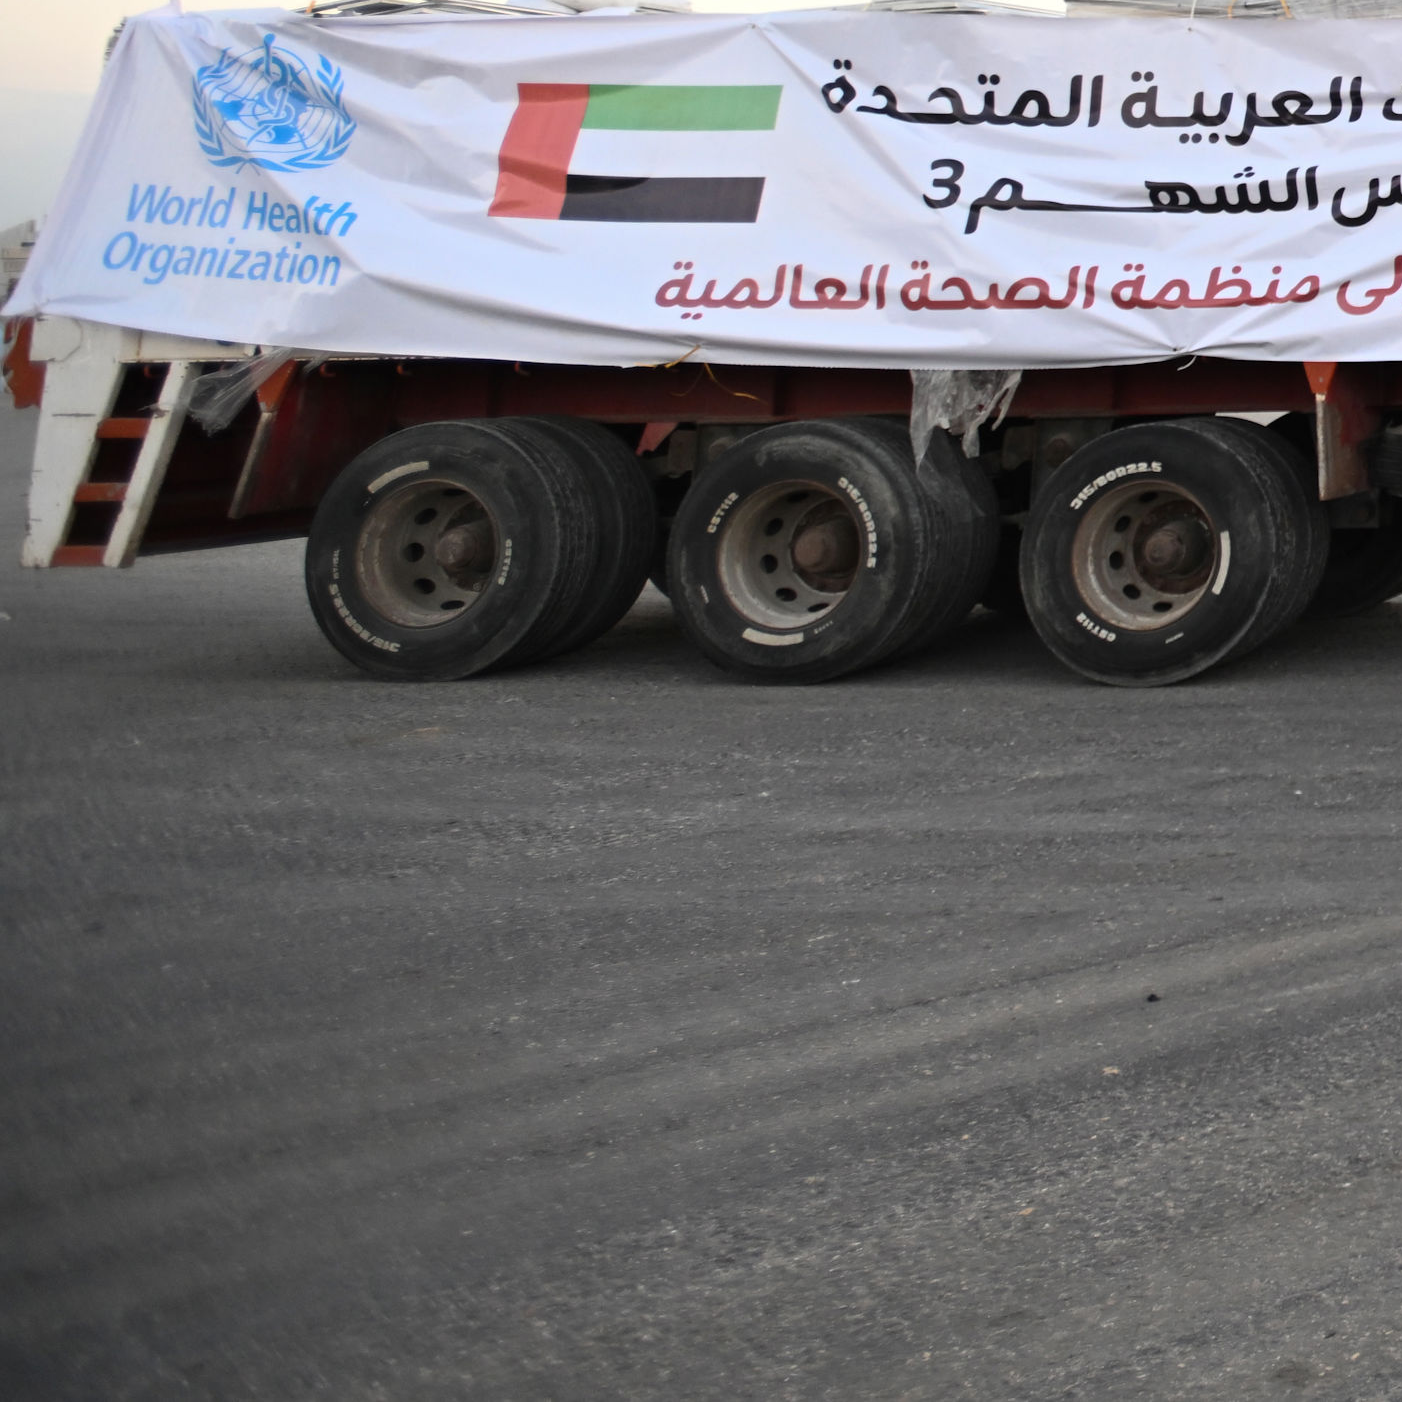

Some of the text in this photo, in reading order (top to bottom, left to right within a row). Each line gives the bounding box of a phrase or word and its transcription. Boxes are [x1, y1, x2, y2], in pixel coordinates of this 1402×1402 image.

[820, 58, 1104, 129] المتحدة
[1120, 71, 1364, 146] العربية
[127, 183, 358, 239] World Health
[921, 158, 965, 210] 3
[963, 166, 1319, 234] الشهم
[102, 231, 342, 288] Organization
[899, 259, 1099, 312] الصحة
[1110, 262, 1320, 311] منظمة
[654, 259, 888, 320] العالمية
